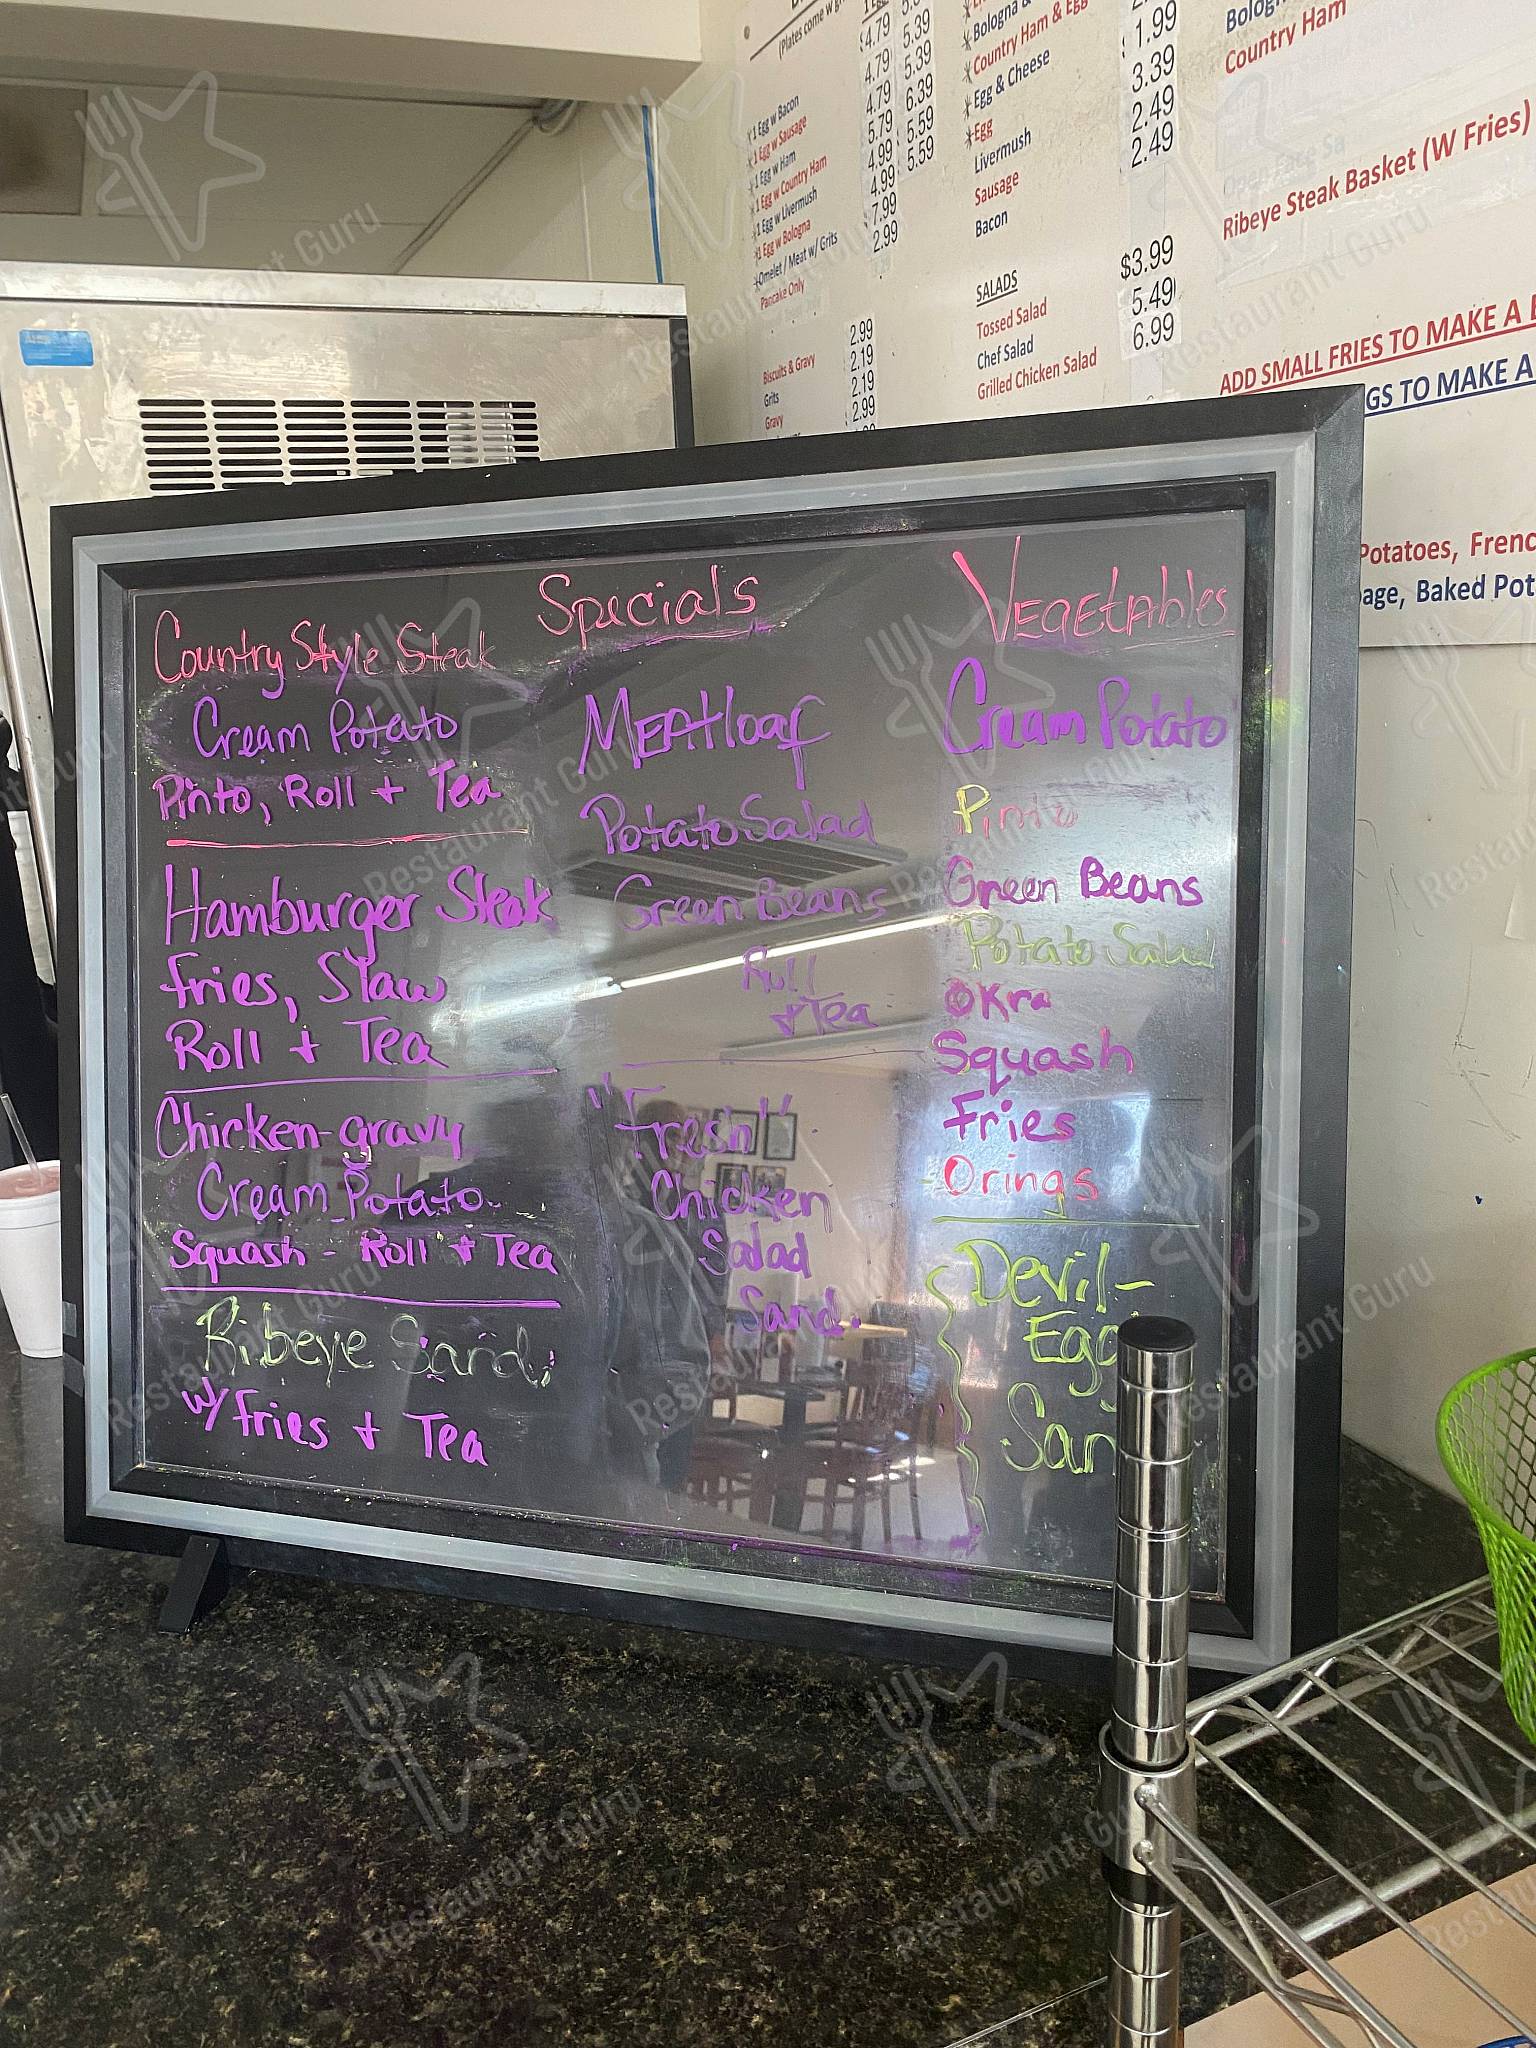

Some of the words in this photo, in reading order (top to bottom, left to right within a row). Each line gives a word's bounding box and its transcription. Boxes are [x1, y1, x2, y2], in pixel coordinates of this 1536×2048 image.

[779, 27, 802, 60] (Plates
[804, 8, 824, 35] come
[865, 12, 890, 48] 4.79
[903, 8, 930, 48] 5.39
[973, 0, 1018, 42] Bologna
[973, 34, 1018, 75] Country
[1021, 14, 1049, 45] Ham
[1053, 1, 1062, 23] &
[1135, 0, 1177, 48] 1.99
[1225, 22, 1296, 74] Country
[1302, 0, 1347, 36] Ham
[865, 48, 890, 84] 4.79
[905, 40, 931, 80] 5.39
[974, 85, 993, 109] Egg
[995, 74, 1004, 94] &
[1008, 49, 1050, 87] Cheese
[1132, 44, 1175, 93] 3.39
[866, 80, 891, 115] 4.79
[906, 73, 933, 112] 6.39
[1132, 84, 1174, 133] 2.49
[758, 119, 769, 136] Egg
[778, 95, 799, 120] Bacon
[779, 116, 807, 145] Sausage
[868, 109, 893, 144] 5.79
[907, 105, 934, 143] 5.59
[974, 118, 993, 142] Egg
[868, 139, 893, 172] 4.99
[907, 135, 934, 172] 5.59
[974, 126, 1031, 174] Livermush
[1131, 121, 1173, 168] 2.49
[760, 168, 771, 185] Egg
[780, 151, 796, 171] Ham
[761, 192, 772, 210] Egg
[781, 167, 808, 195] Country
[809, 155, 827, 176] Ham
[870, 164, 895, 197] 4.99
[975, 171, 1019, 206] Sausage
[1223, 203, 1281, 240] Ribeye
[1286, 175, 1340, 216] Steak
[1345, 147, 1417, 195] Basket
[1423, 128, 1457, 171] (W
[1464, 99, 1531, 150] Fries)
[762, 217, 773, 234] Egg
[782, 185, 818, 220] Livermush
[872, 192, 897, 225] 7.99
[976, 210, 1008, 238] Bacon
[759, 262, 782, 285] Omelet
[788, 248, 806, 268] Meat
[820, 231, 838, 251] Grits
[763, 241, 774, 258] Egg
[783, 219, 811, 245] Bologna
[873, 220, 898, 253] 2.99
[1120, 235, 1174, 280] $3.99
[761, 286, 787, 310] Pancake
[788, 277, 805, 296] Only
[976, 269, 1018, 303] SALADS
[1132, 276, 1174, 316] 5.49
[850, 318, 873, 346] 2.99
[977, 309, 1013, 340] Tossed
[1016, 296, 1047, 325] Salad
[1133, 312, 1174, 350] 6.99
[763, 364, 786, 384] Biscuits
[796, 353, 816, 371] Gravy
[850, 344, 874, 372] 2.19
[977, 345, 1001, 370] Chef
[1004, 334, 1034, 361] Salad
[1219, 367, 1257, 395] ADD
[1261, 350, 1324, 385] SMALL
[1329, 333, 1383, 369] FRIES
[1389, 325, 1419, 354] TO
[1426, 304, 1497, 346] MAKE
[1503, 299, 1522, 327] A
[851, 370, 875, 397] 2.19
[977, 373, 1012, 400] Grilled
[1015, 362, 1060, 388] Chicken
[1063, 346, 1097, 375] Salad
[1400, 376, 1430, 403] TO
[1437, 358, 1508, 397] MAKE
[1515, 353, 1534, 381] A
[764, 391, 779, 407] Grits
[852, 395, 876, 422] 2.99
[765, 415, 783, 430] Gravy
[1360, 540, 1459, 565] Potatoes,
[1471, 532, 1536, 557] Frenc
[538, 565, 759, 650] Specials
[1360, 585, 1406, 611] age,
[1417, 574, 1486, 603] Baked
[1494, 574, 1536, 599] Pot
[154, 610, 286, 698] Country
[290, 620, 383, 694] Style
[395, 621, 497, 675] Steak
[193, 696, 311, 760] Cream
[329, 699, 459, 755] Potato
[943, 657, 1087, 755] Cream
[1096, 674, 1229, 750] Potato
[152, 774, 272, 826] Pinto,
[282, 773, 355, 810] Roll
[427, 759, 503, 813] Tea
[579, 793, 739, 855] Potato
[738, 793, 879, 847] Salad
[614, 874, 746, 932] Green
[753, 877, 888, 923] Beans
[944, 855, 1059, 910] Green
[1079, 856, 1204, 908] Beans
[164, 863, 423, 968] Hamburger
[957, 911, 1096, 972] Potato
[165, 1018, 262, 1074] Roll
[343, 1016, 450, 1069] Tea
[930, 1025, 1135, 1097] Squash
[197, 1161, 328, 1223] Cream
[343, 1168, 486, 1221] Potato
[651, 1169, 834, 1234] Chicken
[168, 1228, 306, 1284] Squash
[360, 1227, 429, 1269] Roll
[480, 1232, 560, 1276] Tea
[697, 1221, 813, 1280] Salad
[196, 1295, 375, 1389] Ribeye
[402, 1411, 489, 1468] Tea
